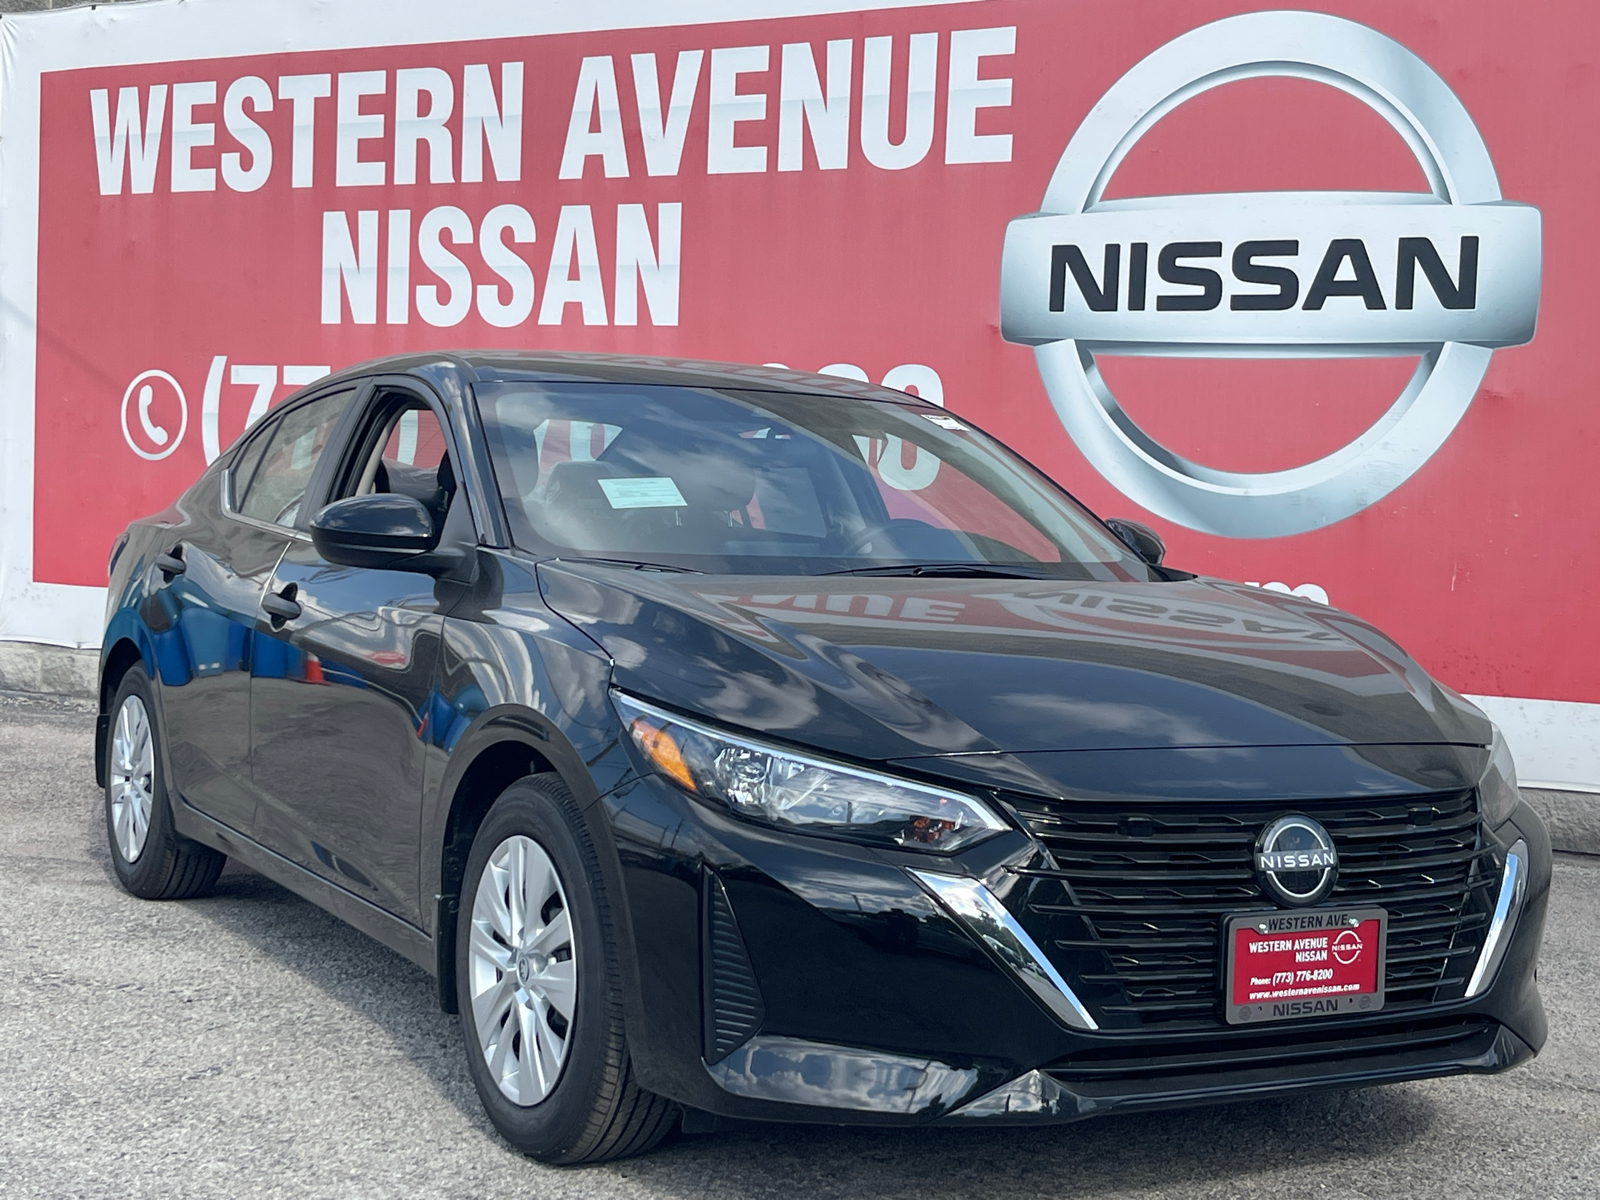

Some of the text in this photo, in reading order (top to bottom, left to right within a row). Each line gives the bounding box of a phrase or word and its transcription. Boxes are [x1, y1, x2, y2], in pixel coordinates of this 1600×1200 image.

[90, 26, 1017, 195] WESTERN AVENUE
[321, 203, 682, 327] NISSAN
[1049, 236, 1479, 312] NISSAN
[1260, 852, 1334, 868] NISSAN
[1268, 915, 1323, 930] WESTERN
[1249, 937, 1328, 953] WESTERN AVENUE
[1332, 943, 1363, 952] NISSAN
[1295, 950, 1328, 963] NISSAN
[1250, 968, 1333, 986] Phone: (773) 776-8200
[1249, 983, 1360, 1000] www.westernavenissan.com
[1273, 999, 1338, 1016] NISSAN
